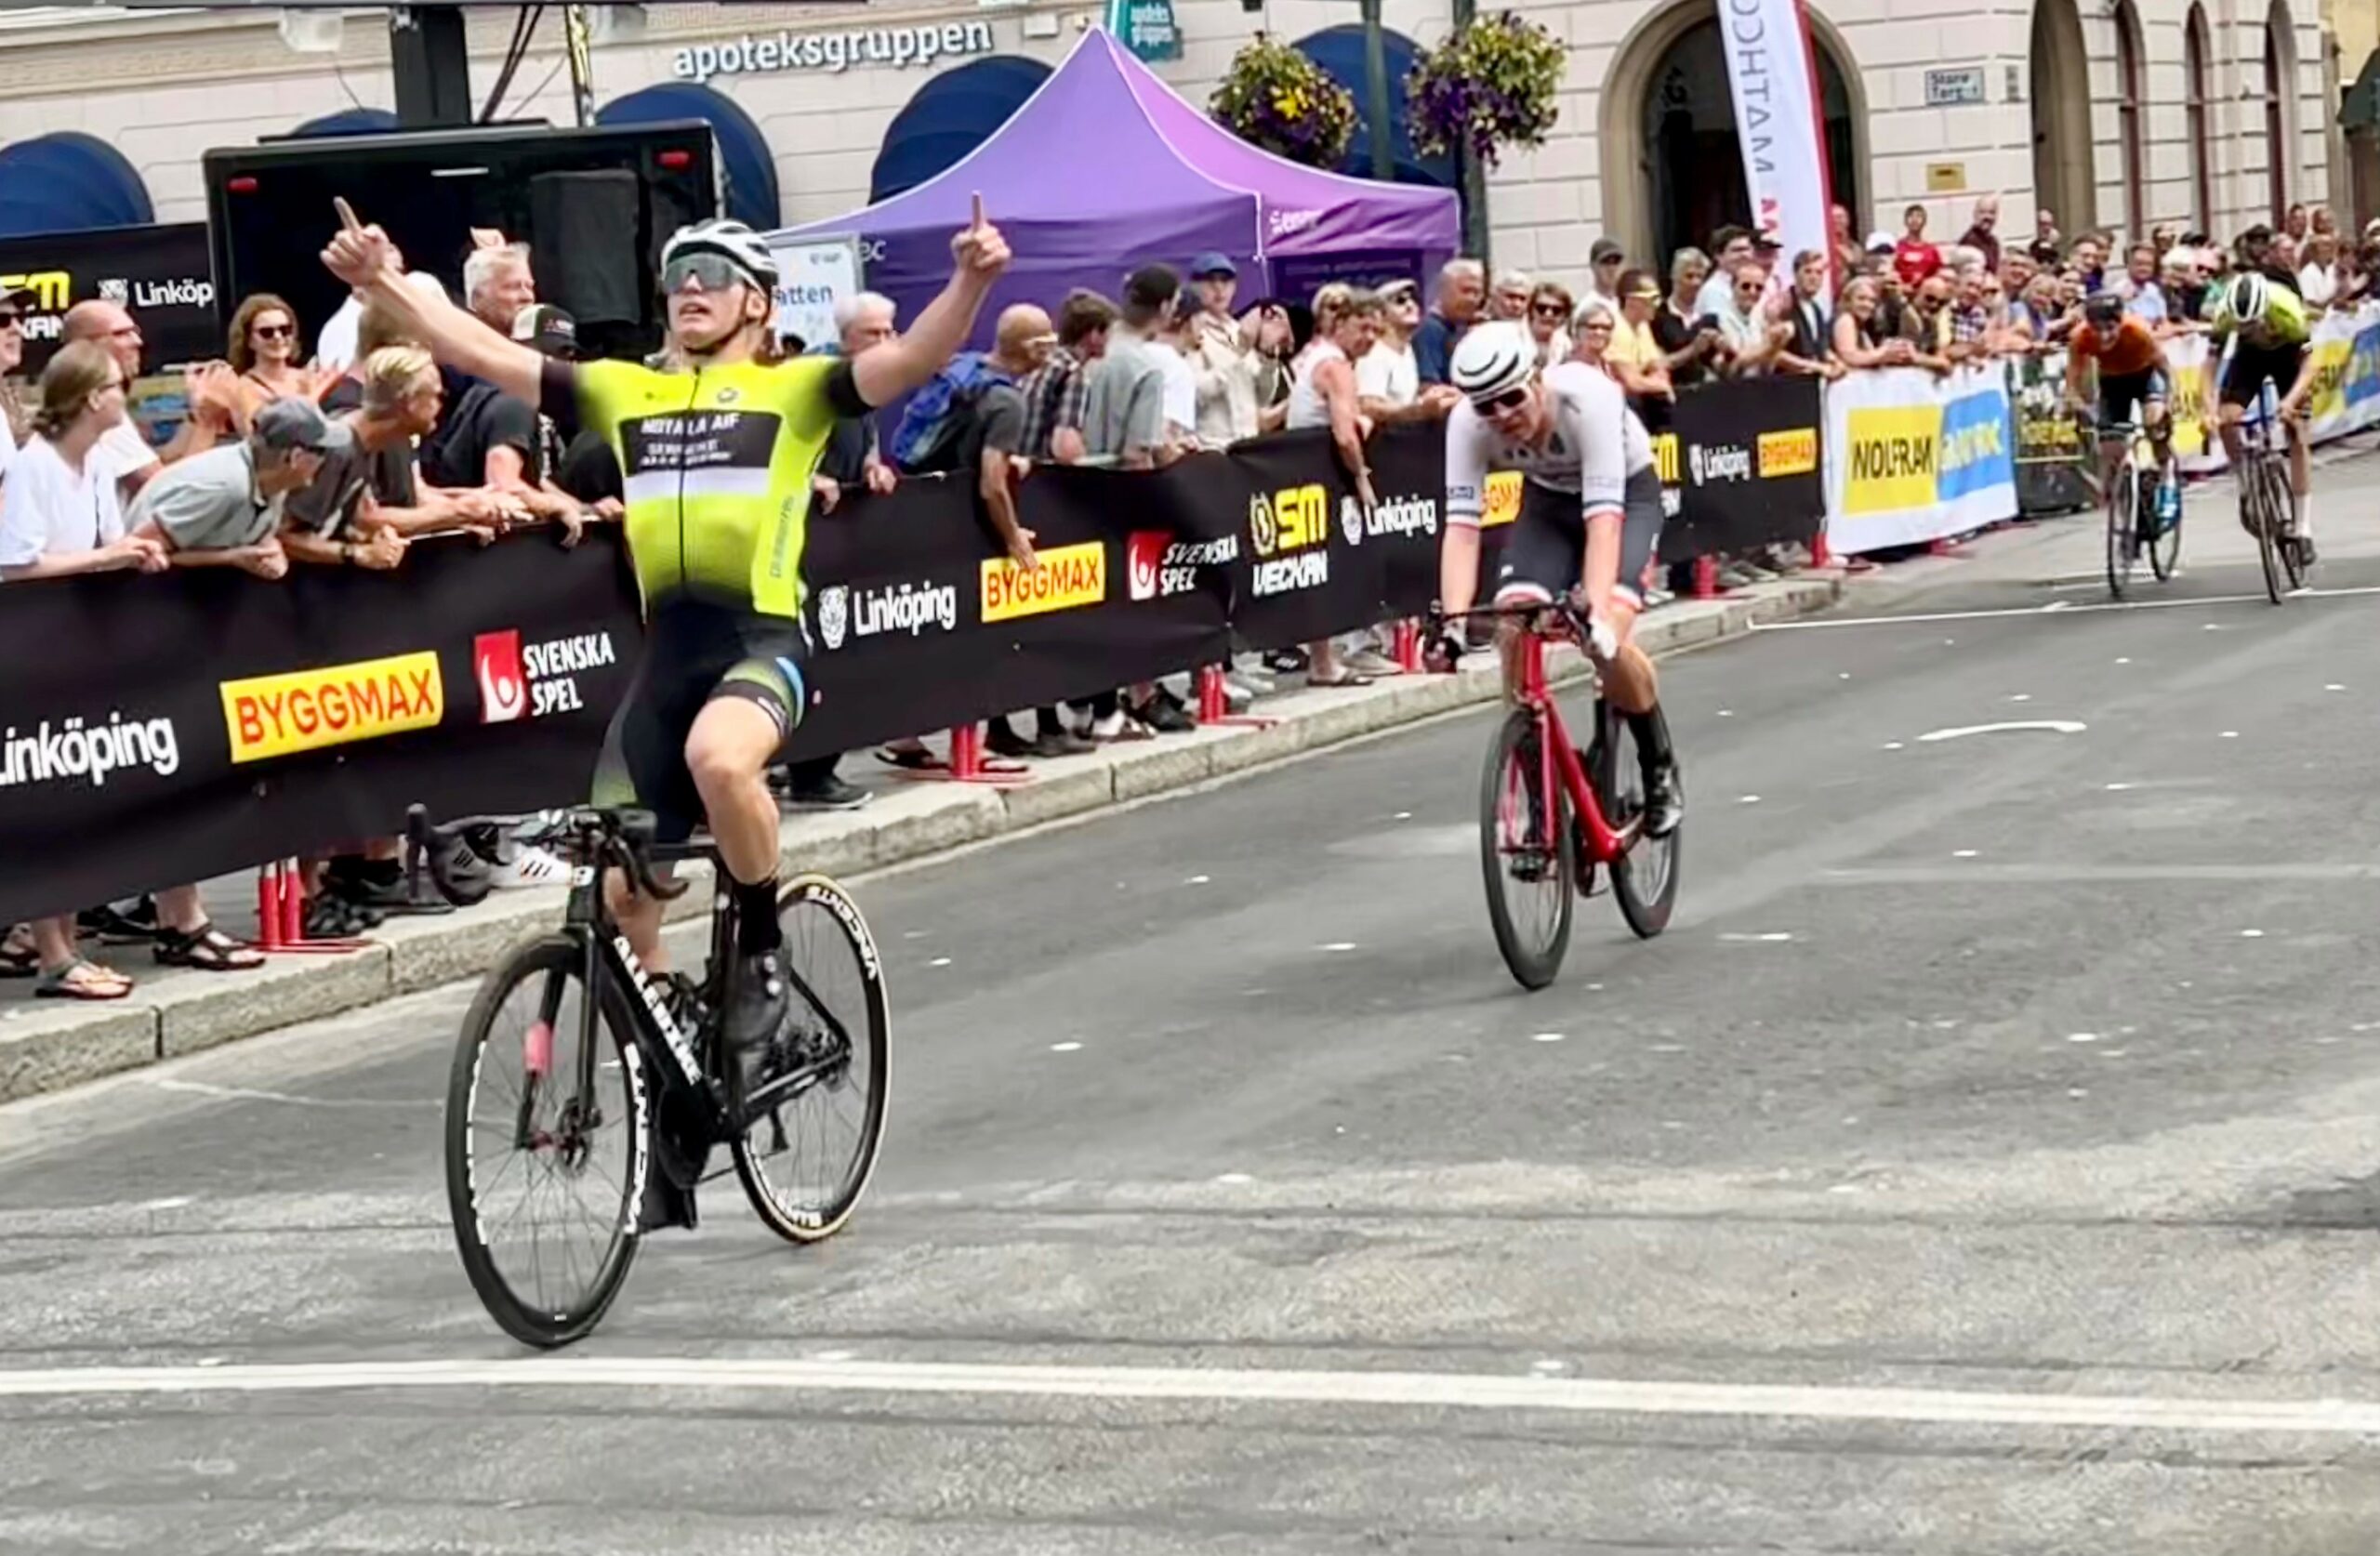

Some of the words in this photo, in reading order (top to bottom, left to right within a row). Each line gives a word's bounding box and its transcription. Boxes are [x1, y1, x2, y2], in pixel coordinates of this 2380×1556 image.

[673, 21, 992, 84] apoteksgruppen
[1275, 483, 1327, 550] SM
[986, 557, 1099, 608] BYGGMAX
[1159, 566, 1197, 597] SPEL
[1252, 550, 1328, 597] VECKAN
[854, 579, 956, 636] Linköping
[522, 631, 615, 679] SVENSKA
[235, 668, 435, 745] BYGGMAX
[531, 677, 583, 717] SPEL
